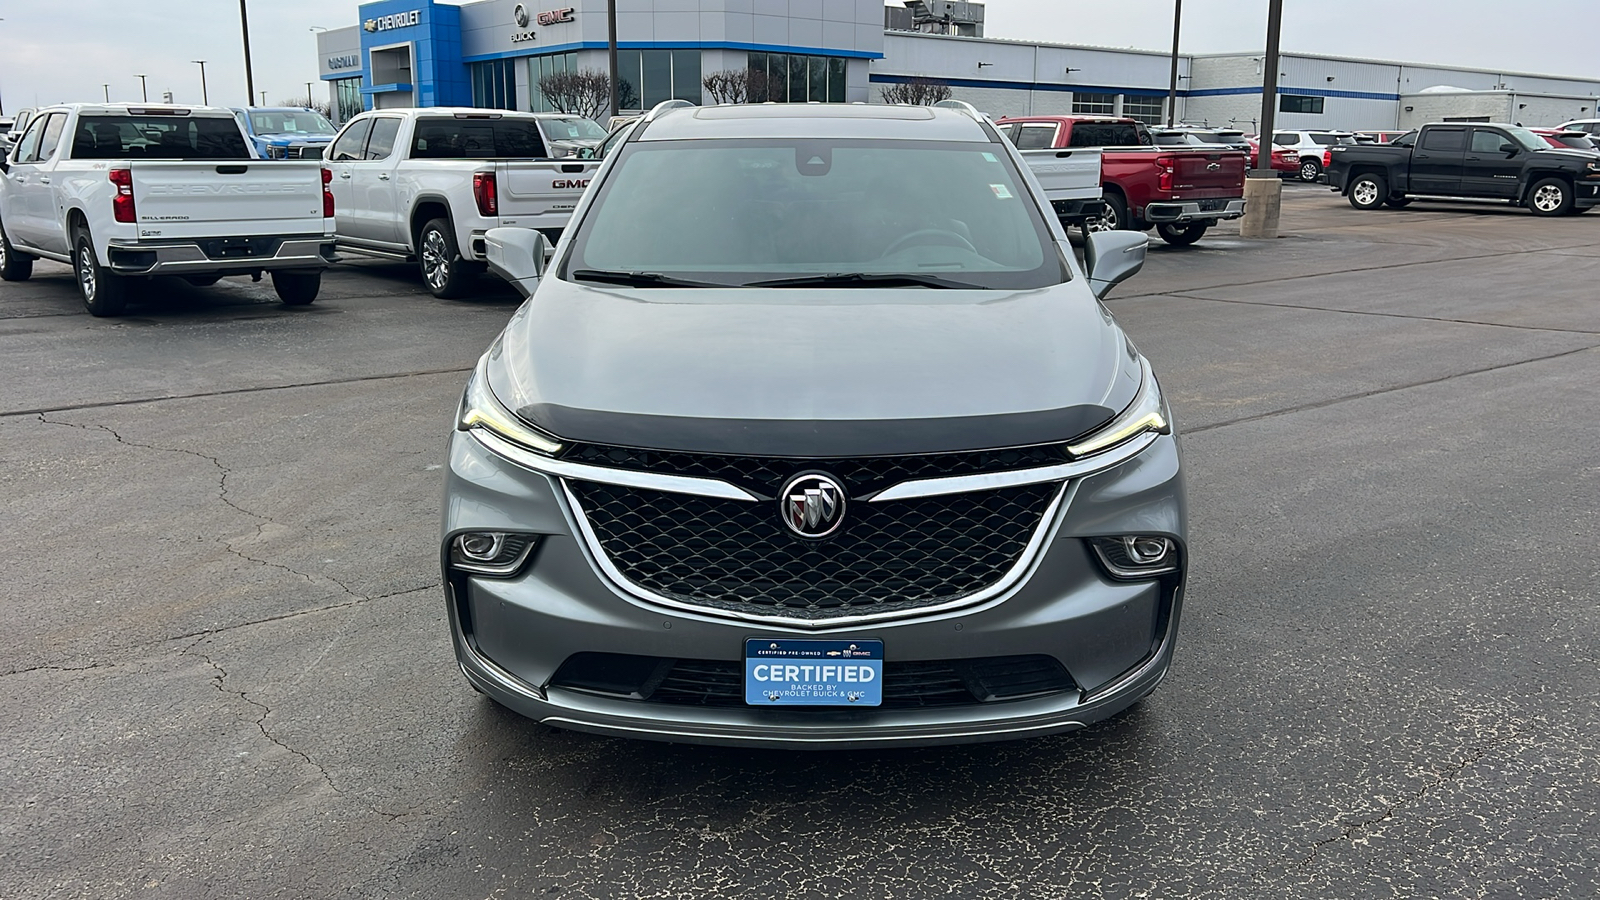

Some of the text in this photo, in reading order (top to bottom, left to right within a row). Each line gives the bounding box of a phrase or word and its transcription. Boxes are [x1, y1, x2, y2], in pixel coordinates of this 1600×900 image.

[377, 10, 420, 31] CHEVROLET
[537, 8, 575, 26] GMC
[510, 31, 536, 43] BUICK
[149, 183, 312, 196] CHEVROLET
[753, 664, 875, 683] CERTIFIED
